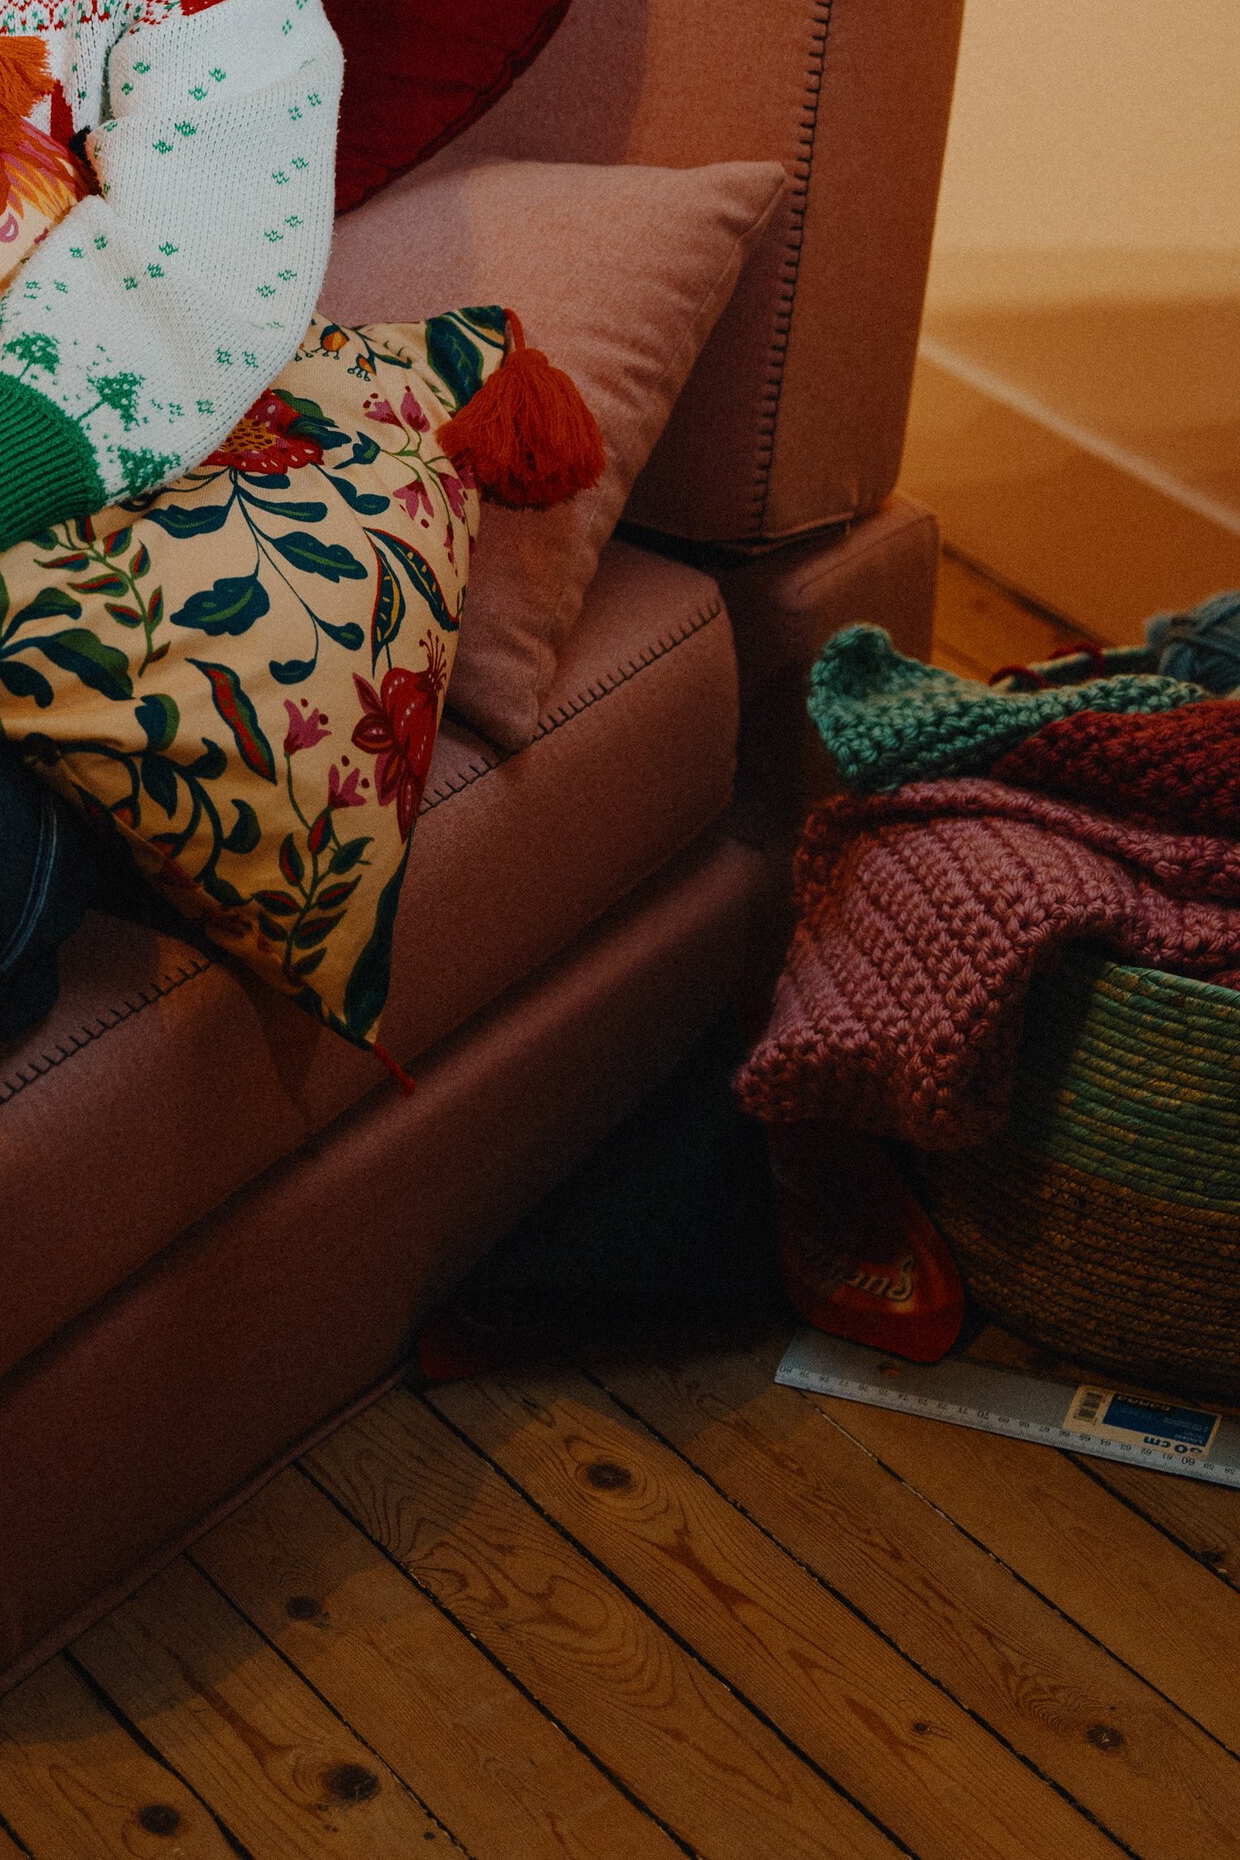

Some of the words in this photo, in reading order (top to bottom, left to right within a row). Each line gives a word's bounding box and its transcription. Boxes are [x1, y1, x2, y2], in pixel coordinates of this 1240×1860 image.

[976, 1410, 990, 1420] 70
[1039, 1425, 1050, 1433] 67
[1143, 1436, 1170, 1448] cm
[1140, 1448, 1152, 1456] 62
[1162, 1453, 1172, 1461] 61
[1181, 1456, 1196, 1466] 60
